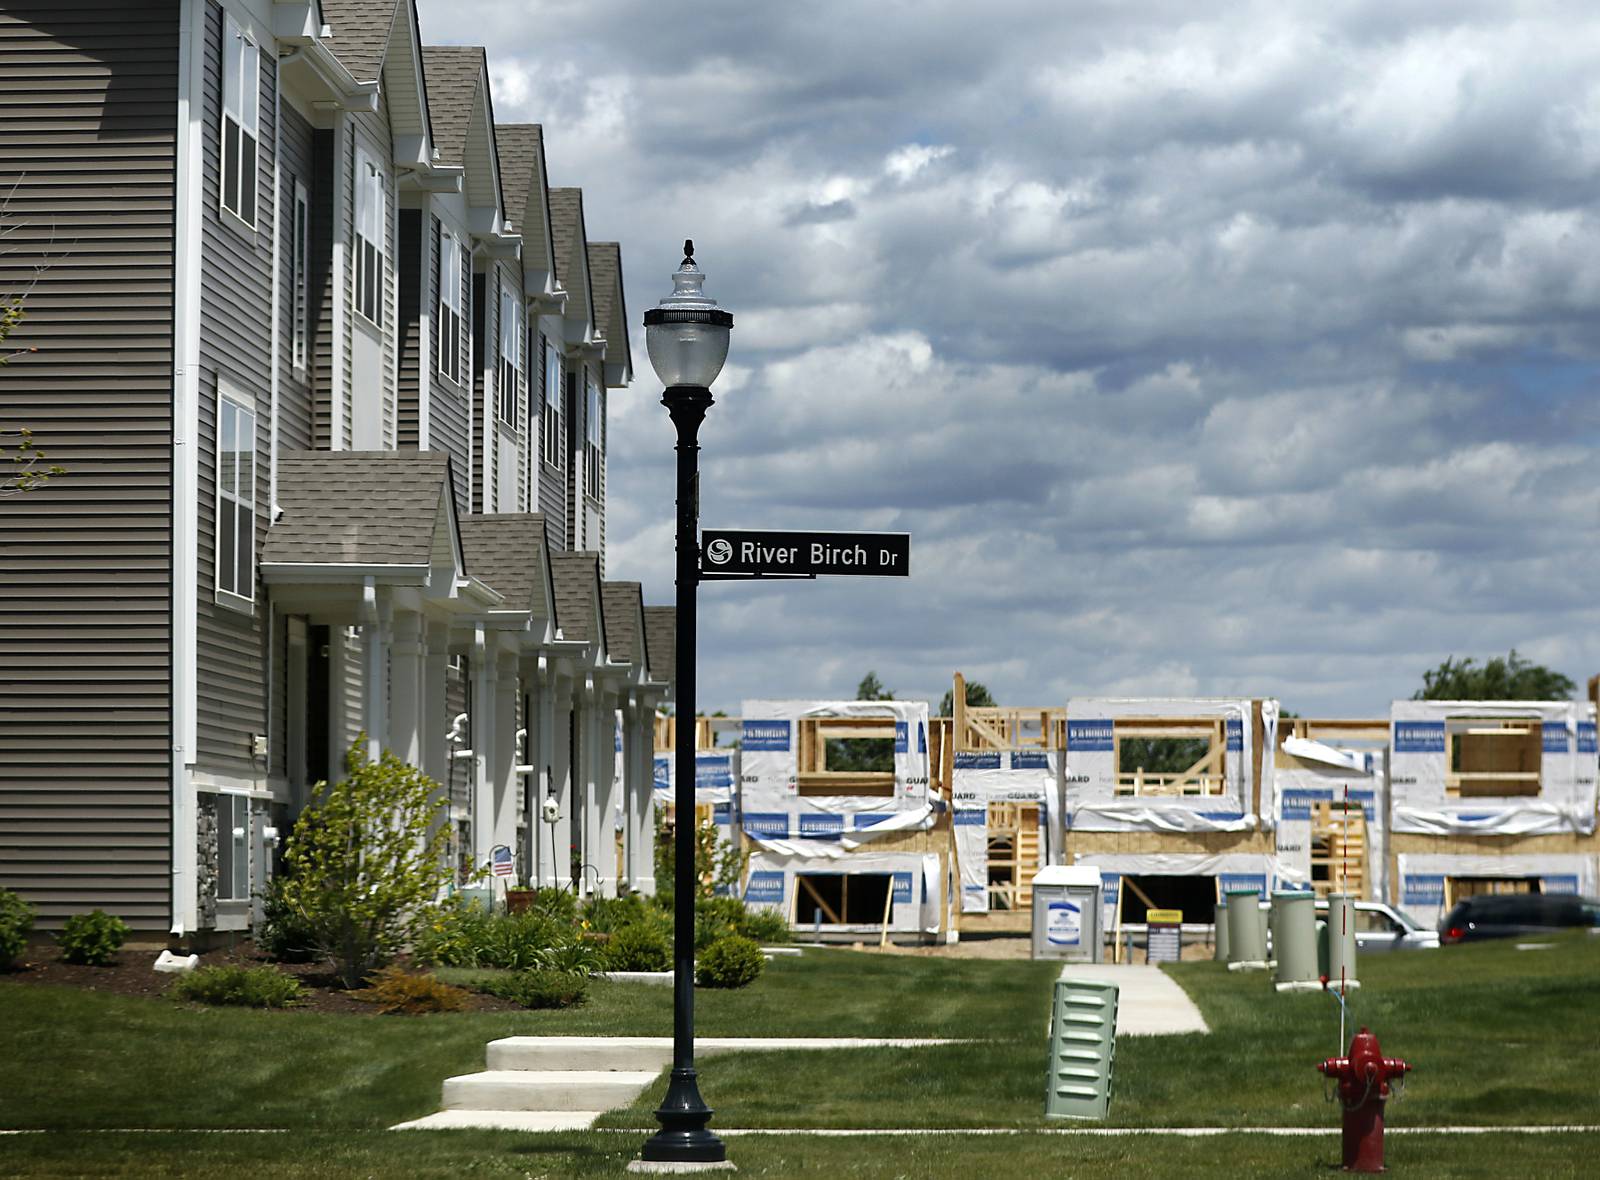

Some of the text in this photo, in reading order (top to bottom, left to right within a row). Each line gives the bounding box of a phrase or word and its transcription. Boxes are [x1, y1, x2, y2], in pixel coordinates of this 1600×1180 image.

[741, 541, 898, 566] River Birch Dr
